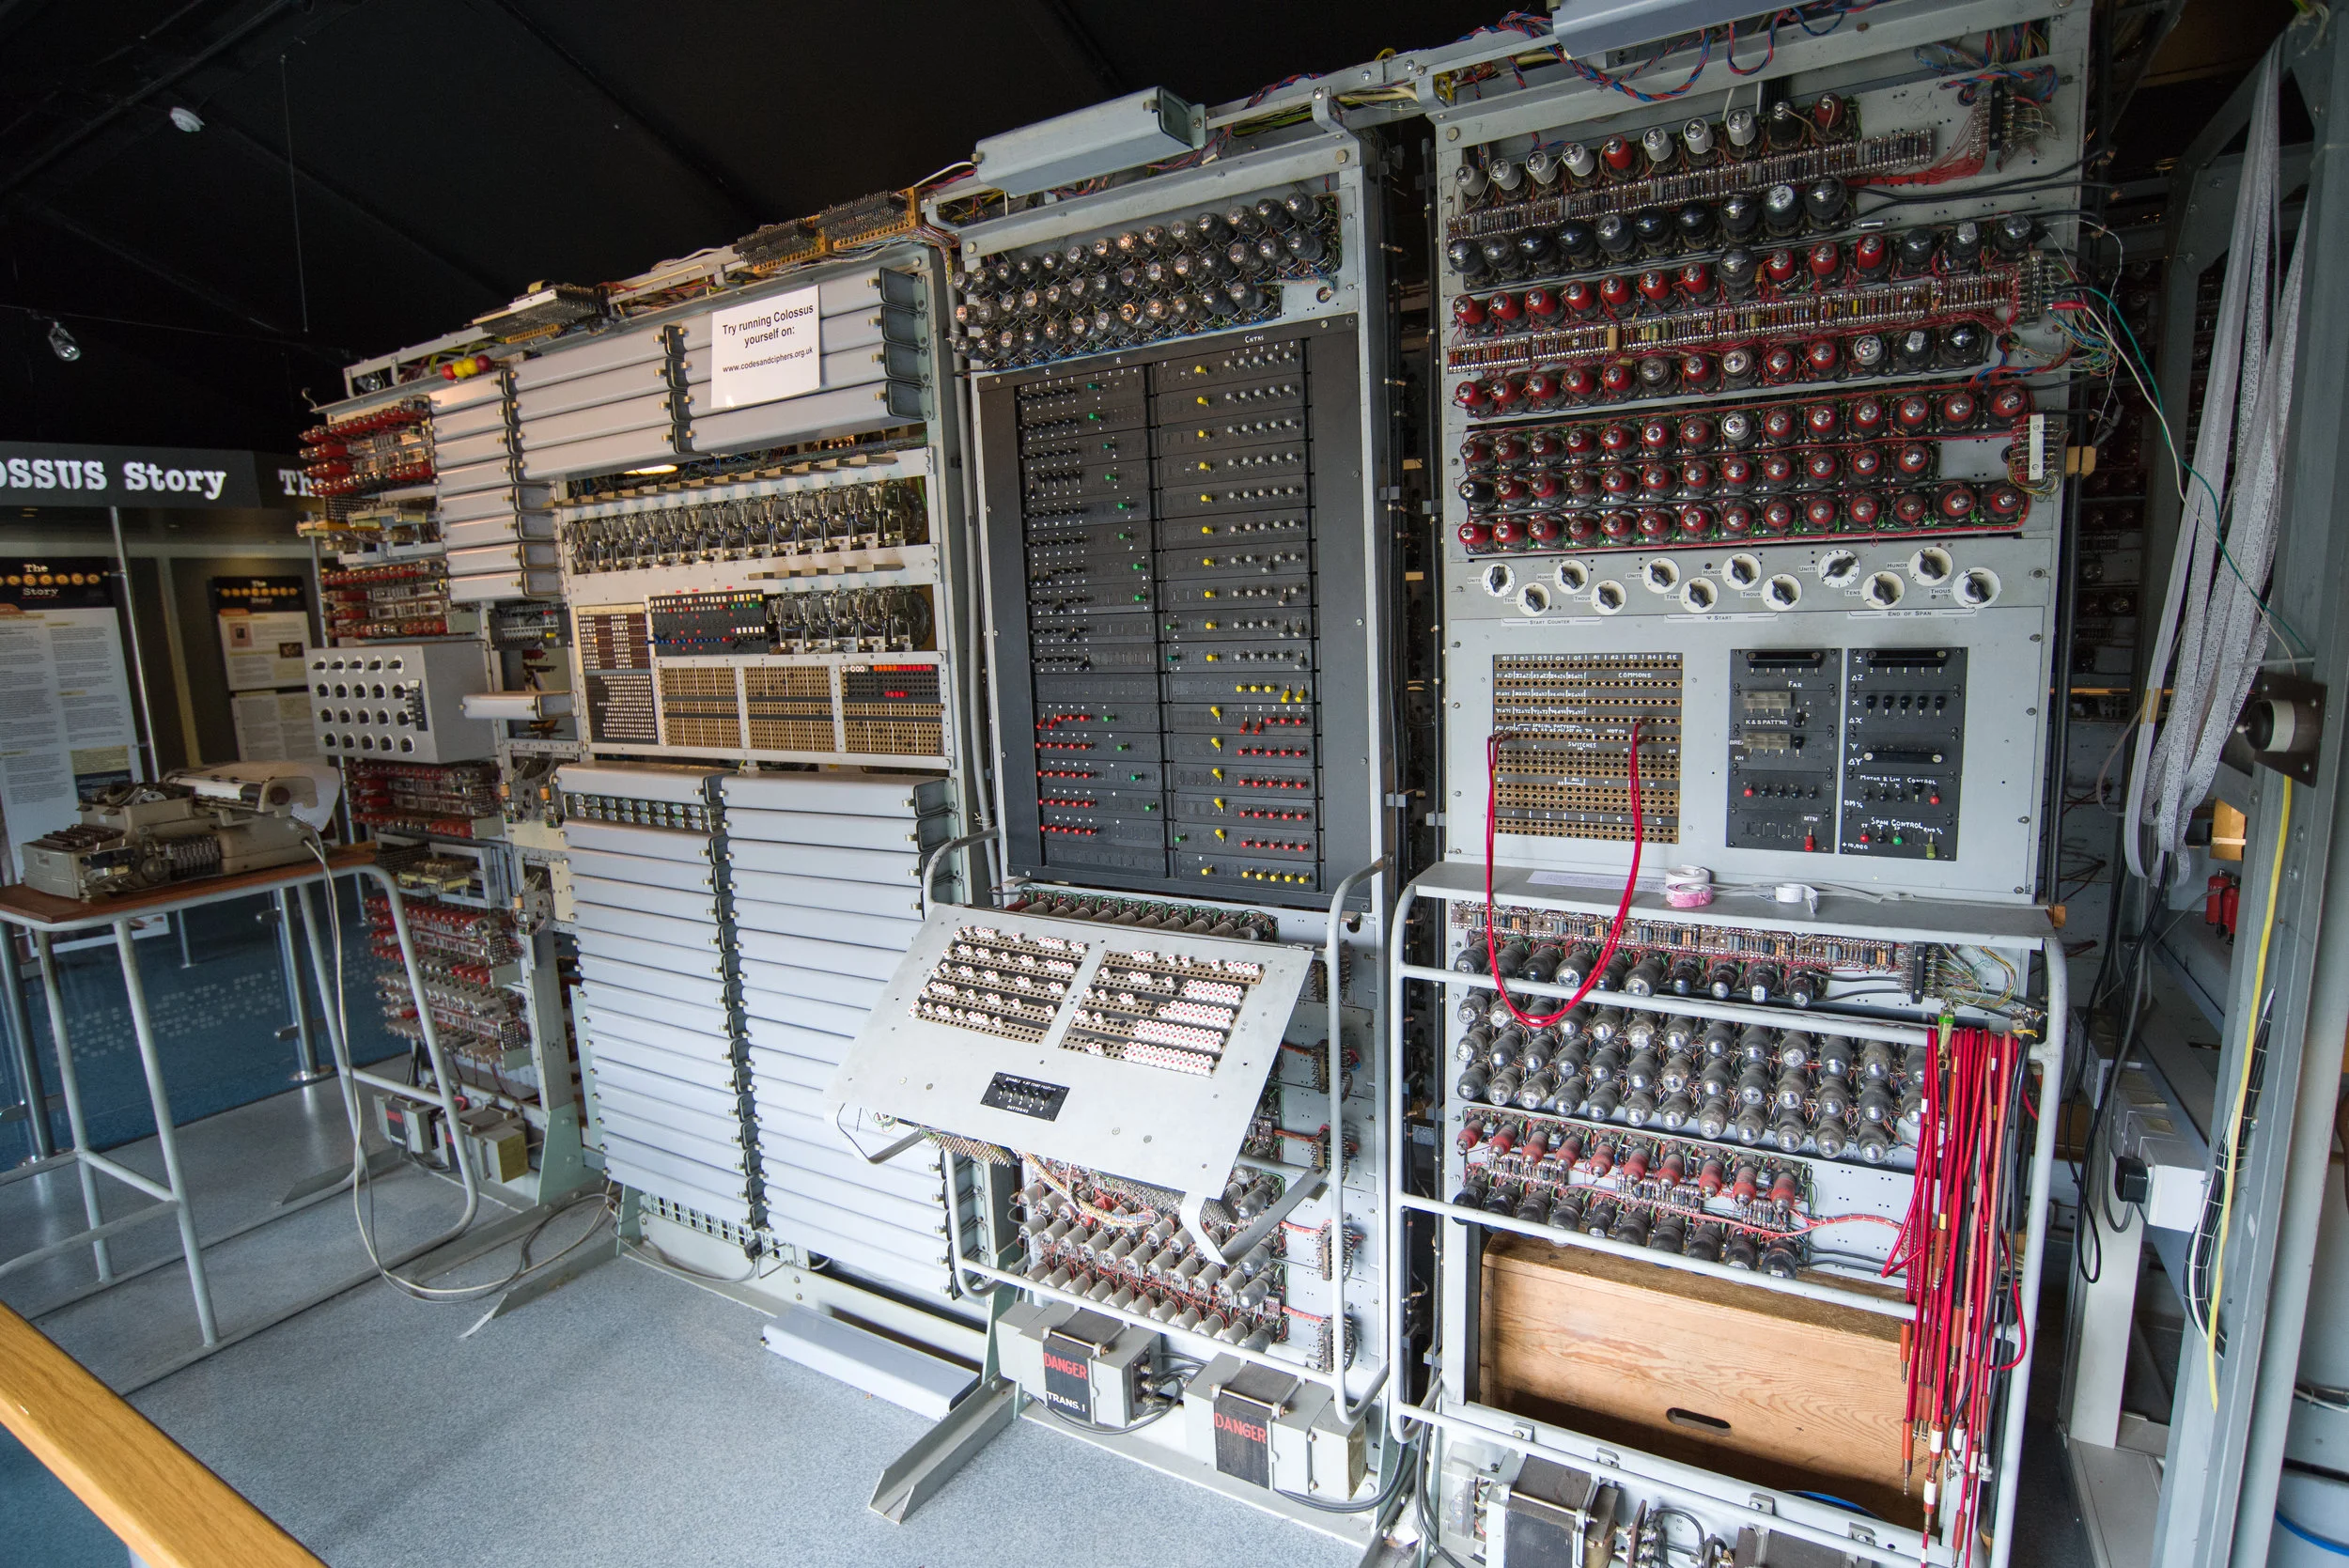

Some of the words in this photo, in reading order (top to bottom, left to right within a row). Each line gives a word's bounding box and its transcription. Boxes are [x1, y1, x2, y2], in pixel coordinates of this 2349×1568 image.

[723, 324, 737, 336] Try
[739, 317, 771, 331] running
[773, 304, 814, 323] Colossus
[744, 328, 779, 349] yourself
[781, 326, 795, 337] on:
[723, 347, 813, 373] www.codesandciphers.org.uk
[123, 460, 226, 501] Story
[23, 564, 49, 573] The
[23, 588, 59, 597] Story
[1871, 817, 1889, 826] SPAN
[1891, 819, 1923, 829] CONTROL
[1044, 1352, 1088, 1381] DANGER
[1215, 1412, 1267, 1444] DANGER
